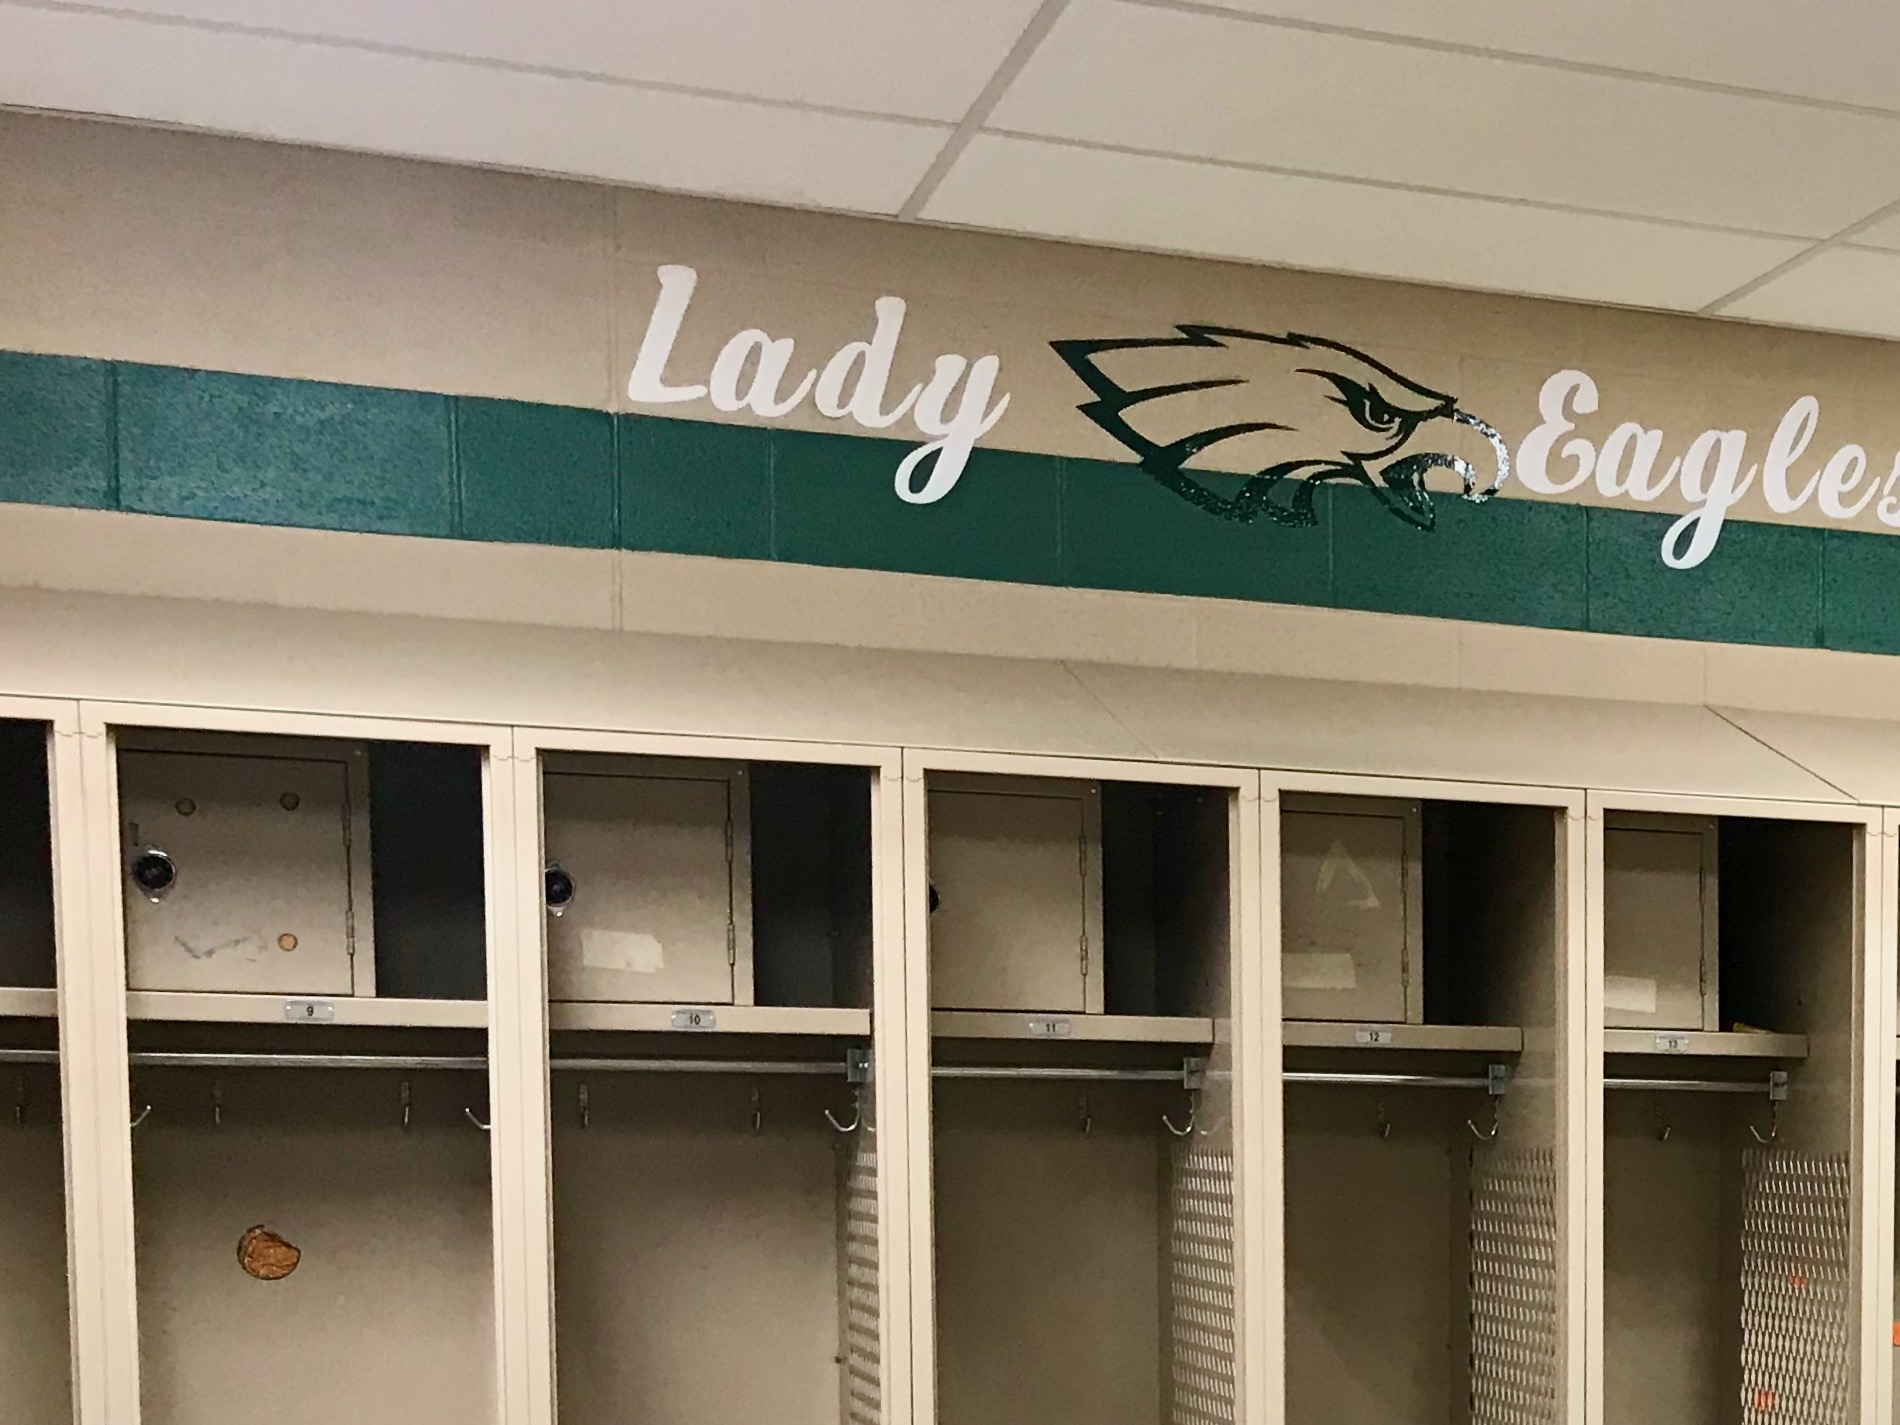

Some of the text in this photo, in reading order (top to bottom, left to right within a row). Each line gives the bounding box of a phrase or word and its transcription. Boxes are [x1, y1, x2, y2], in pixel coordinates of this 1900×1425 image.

[628, 264, 1010, 504] Lady
[306, 1005, 314, 1017] 9
[689, 1014, 701, 1025] 10
[1045, 1022, 1056, 1033] 11
[1369, 1032, 1380, 1042] 12
